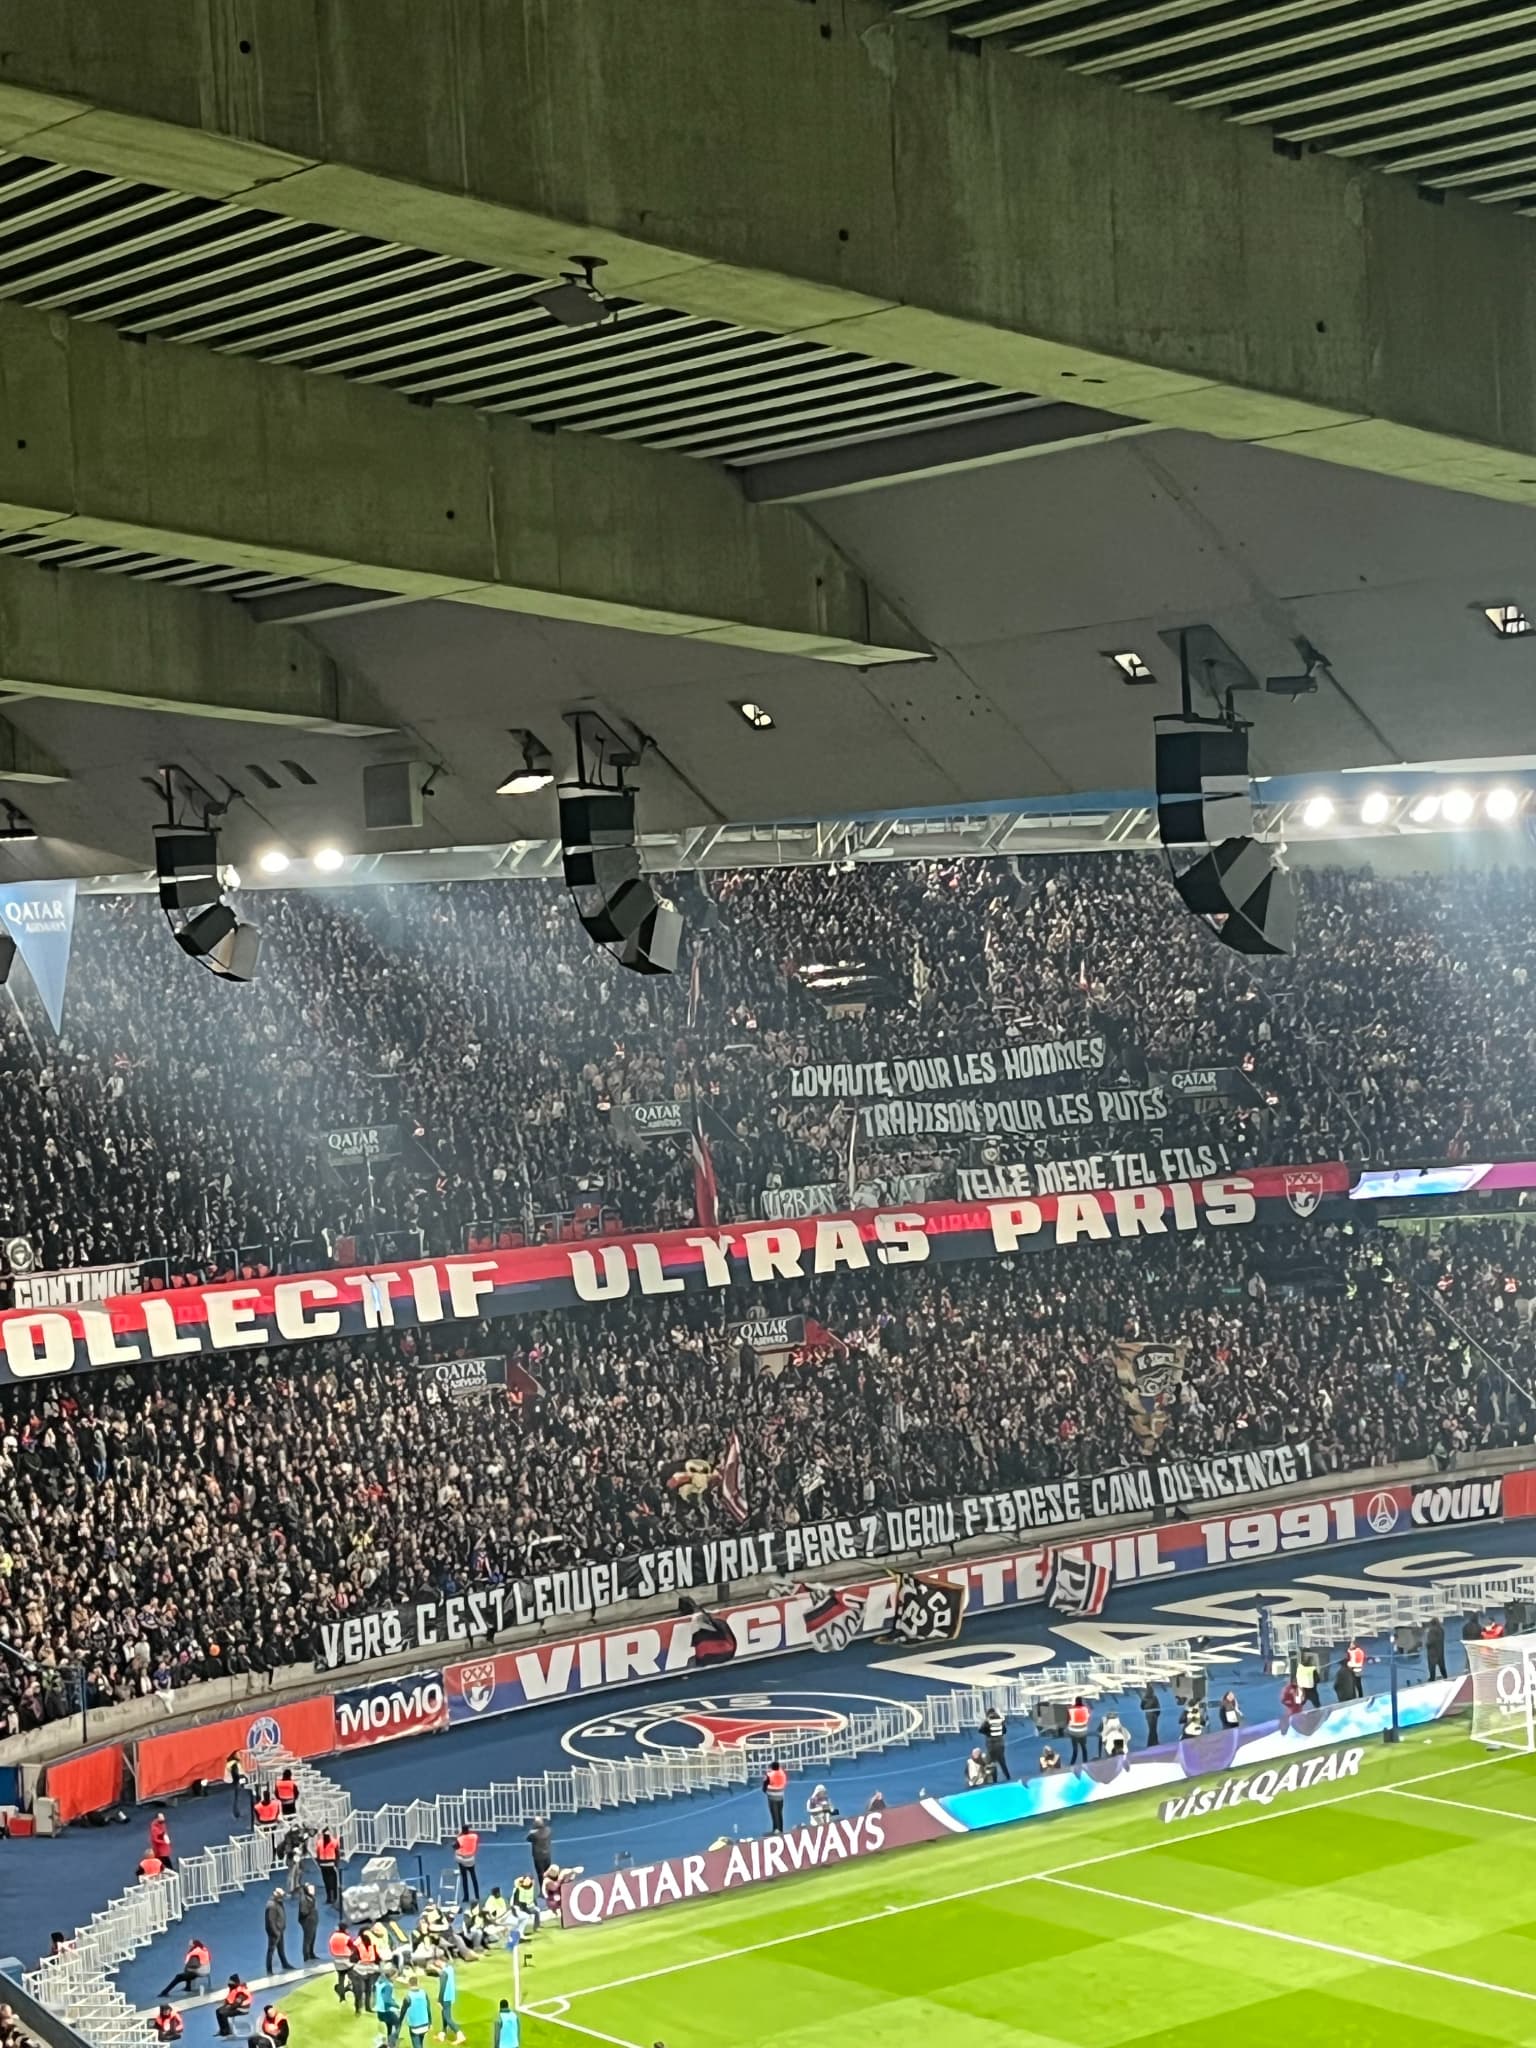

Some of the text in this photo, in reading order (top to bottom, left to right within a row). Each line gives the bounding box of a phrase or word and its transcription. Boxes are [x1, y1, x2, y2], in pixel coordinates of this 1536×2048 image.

[5, 900, 65, 925] QATAR
[790, 1037, 1105, 1098] LOYAUTE POUR LES HOMMES
[1171, 1071, 1216, 1089] QATAR
[635, 1104, 681, 1124] QATAR
[860, 1087, 1168, 1138] TRAHISON POUR LES PUTES
[328, 1129, 380, 1150] QATAR
[956, 1163, 1031, 1202] TELLE
[1112, 1151, 1156, 1187] TEL
[1161, 1145, 1217, 1181] FILS
[566, 1213, 931, 1303] ULTRAS
[986, 1176, 1256, 1253] PARIS
[14, 1265, 142, 1310] CONTINUE
[740, 1319, 788, 1340] QATAR
[435, 1360, 487, 1383] QATAR
[702, 1532, 778, 1584] VRAI
[785, 1520, 857, 1572] PERE
[1091, 1468, 1156, 1517] CANA
[1192, 1445, 1298, 1499] HEINZE
[515, 1605, 816, 1699] VIRAG
[1201, 1498, 1356, 1565] 1991
[335, 1682, 443, 1736] MOMO
[581, 1695, 772, 1739] PARIS
[569, 1811, 886, 1924] QATAR AIRWAYS
